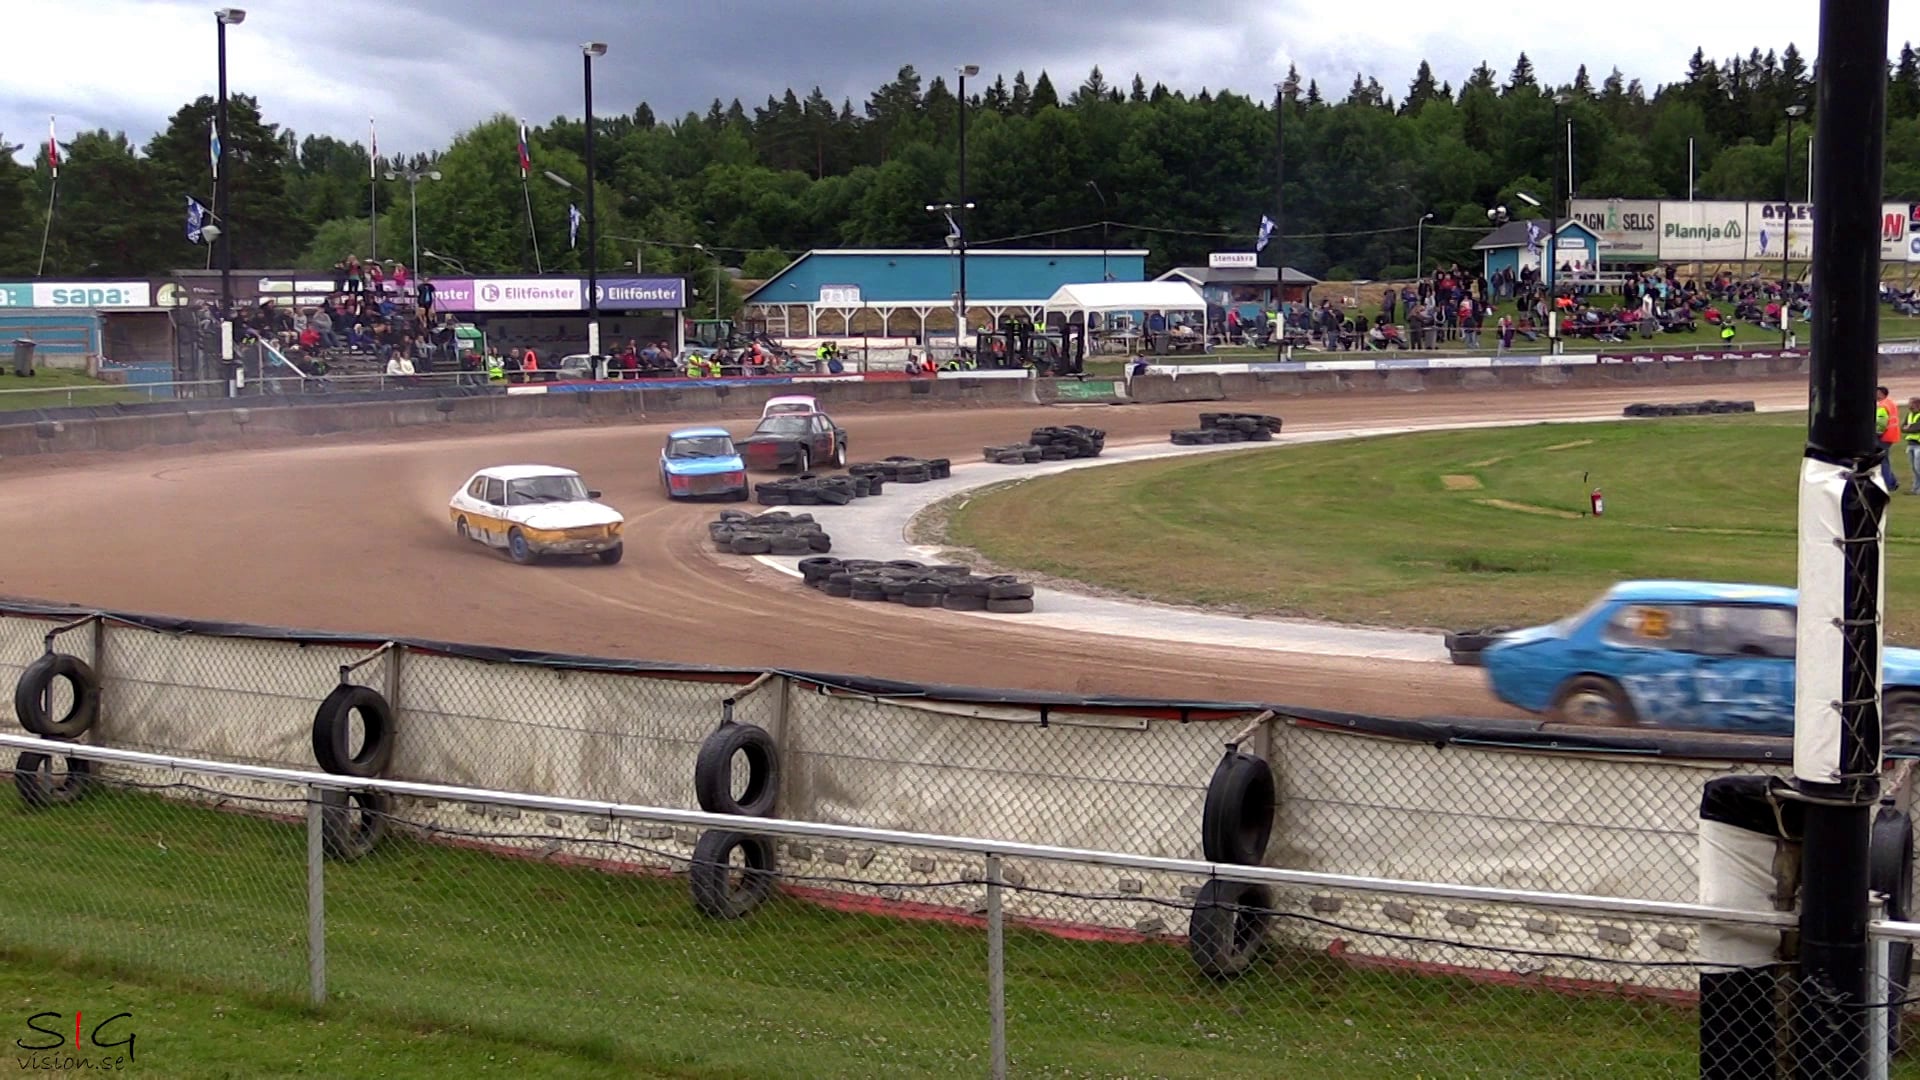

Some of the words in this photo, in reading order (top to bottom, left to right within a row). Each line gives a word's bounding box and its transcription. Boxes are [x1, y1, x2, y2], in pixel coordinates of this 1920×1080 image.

[1622, 213, 1655, 231] SELLS
[1664, 223, 1721, 241] Plannja
[52, 288, 131, 307] sapa:
[505, 287, 575, 300] Elitfönster
[608, 286, 677, 300] Elitfönster
